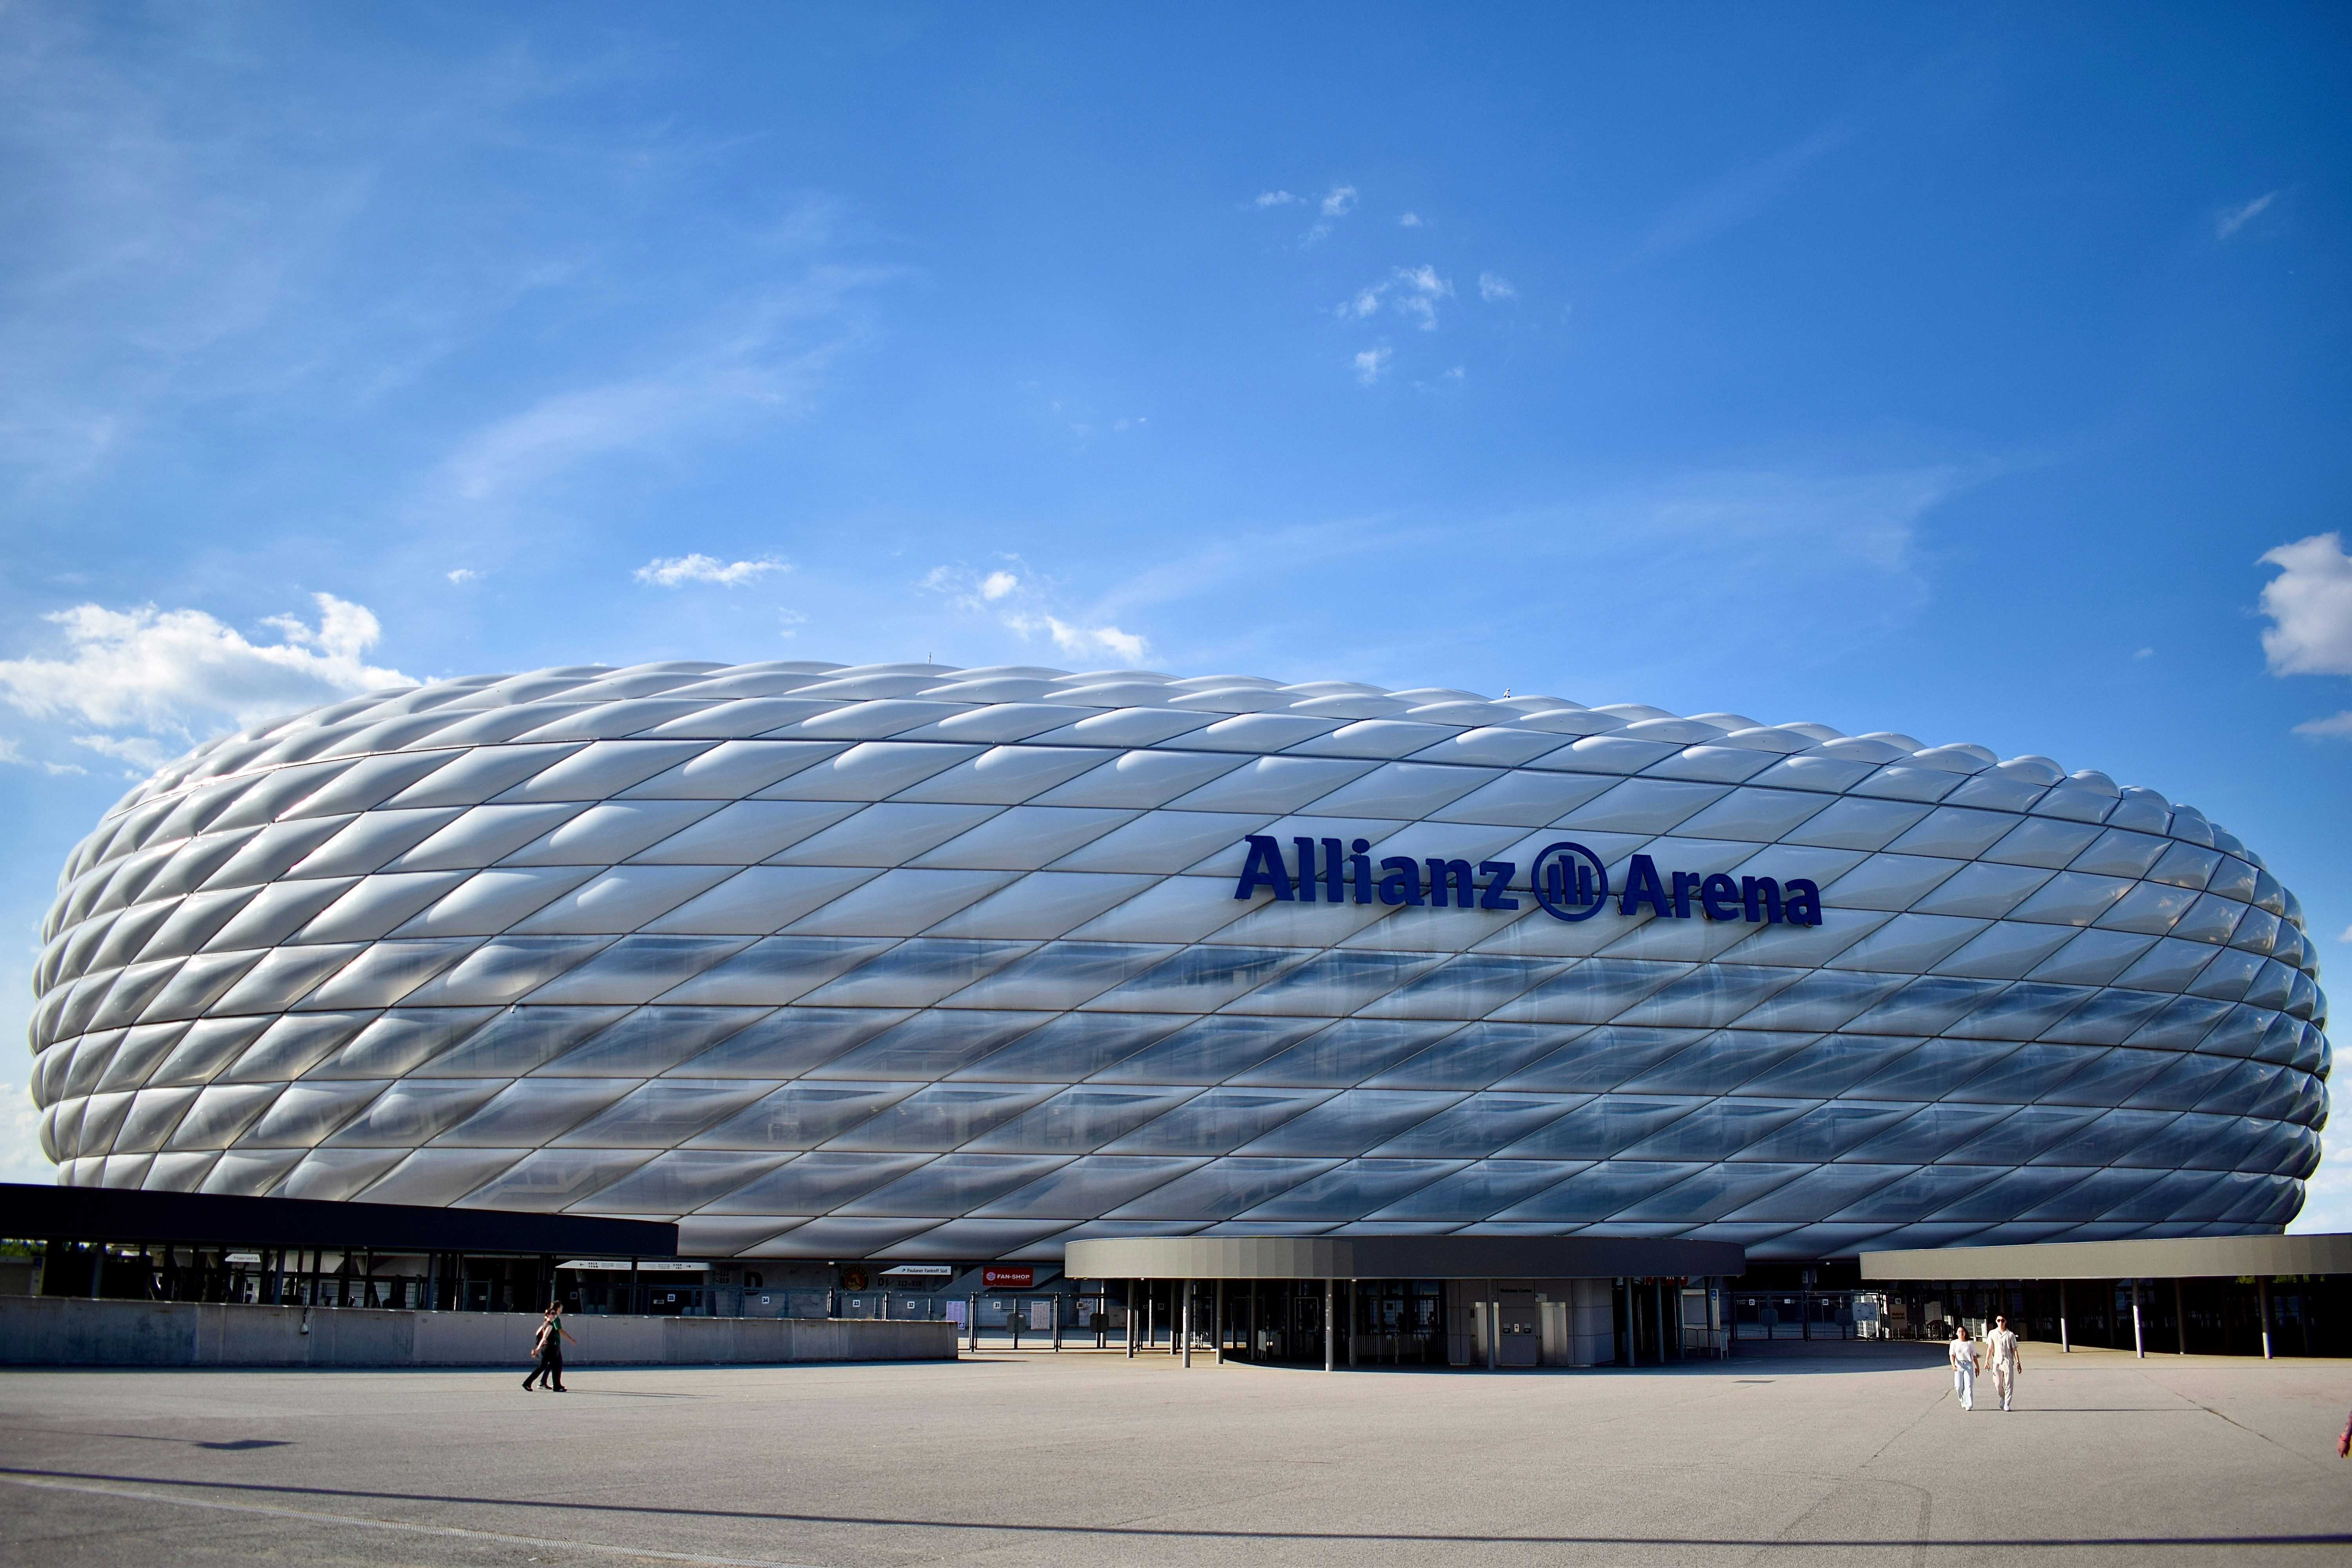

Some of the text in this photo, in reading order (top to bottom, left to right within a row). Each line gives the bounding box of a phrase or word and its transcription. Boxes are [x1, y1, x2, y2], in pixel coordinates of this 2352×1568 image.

[1234, 835, 1823, 926] Allianz Arena
[878, 1278, 884, 1286] D
